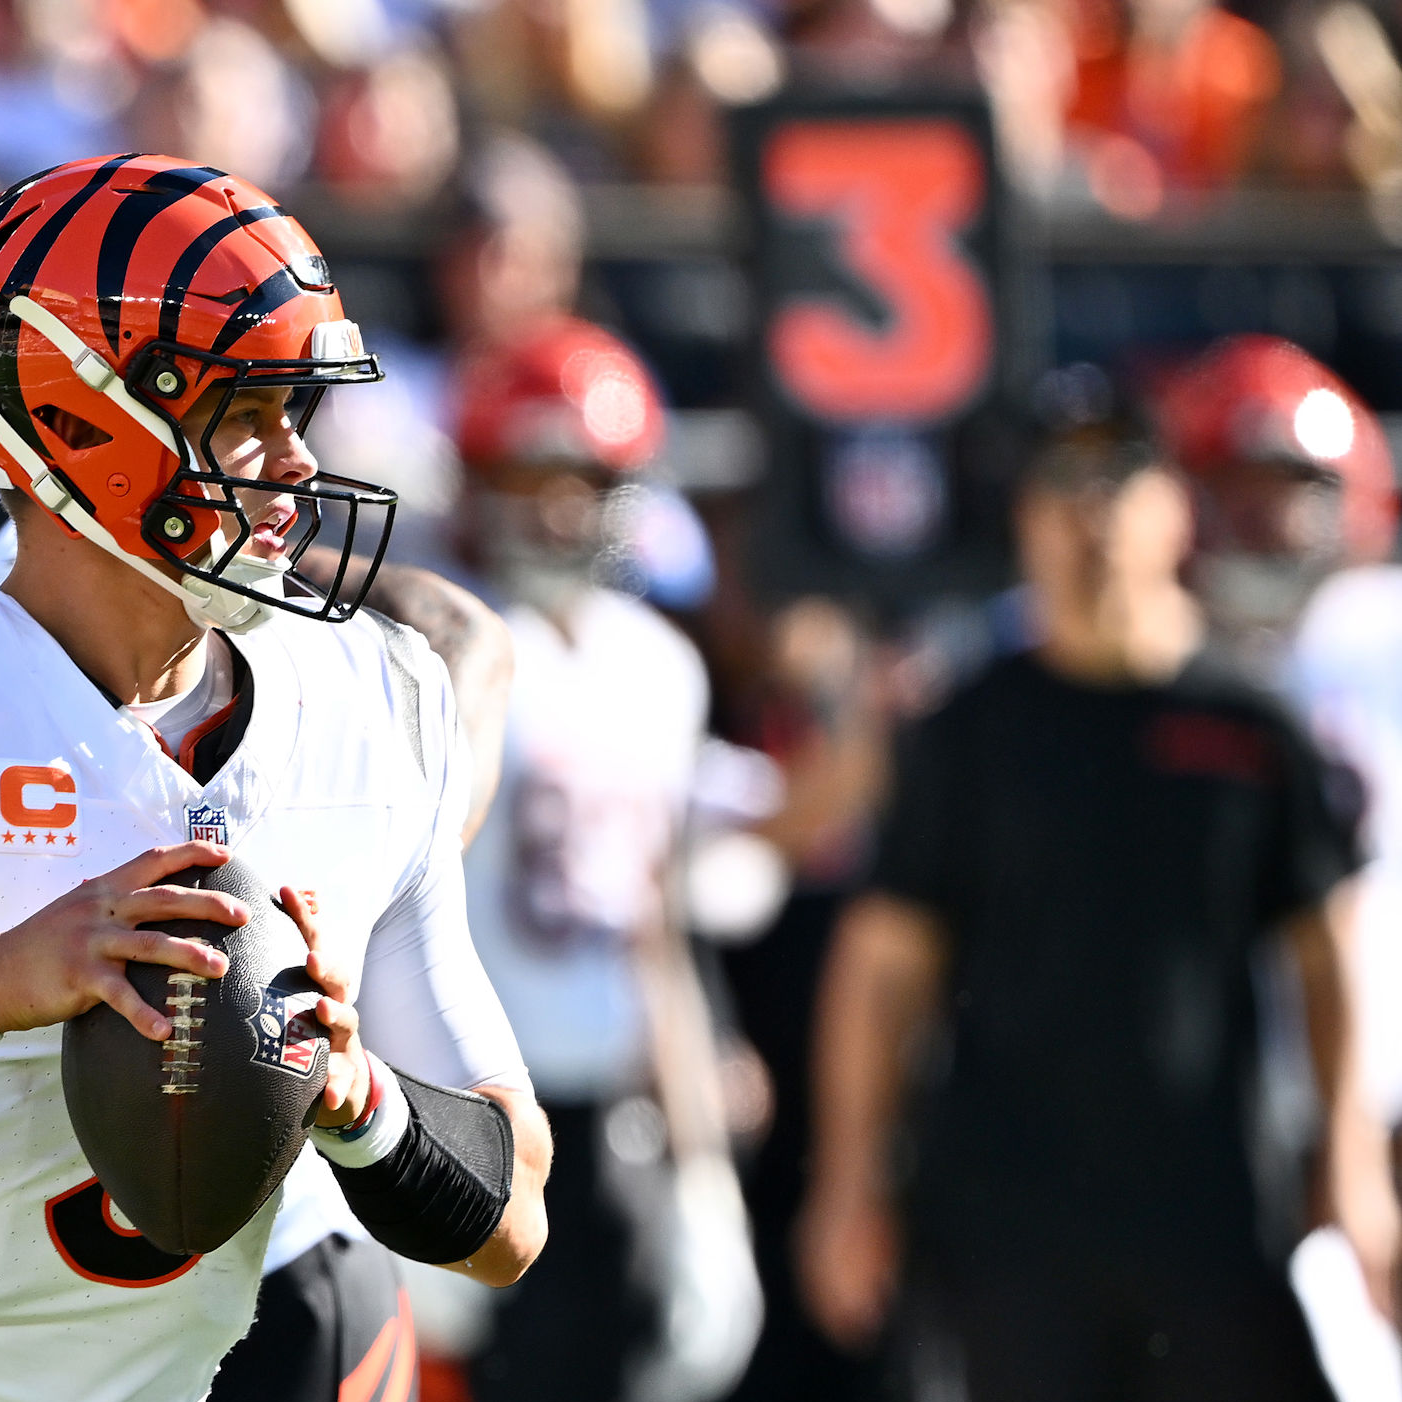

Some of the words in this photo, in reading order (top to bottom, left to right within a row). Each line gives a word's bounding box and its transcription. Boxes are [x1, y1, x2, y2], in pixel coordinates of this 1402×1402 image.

[764, 118, 991, 418] 3
[0, 765, 77, 829] C
[193, 826, 224, 845] NFL
